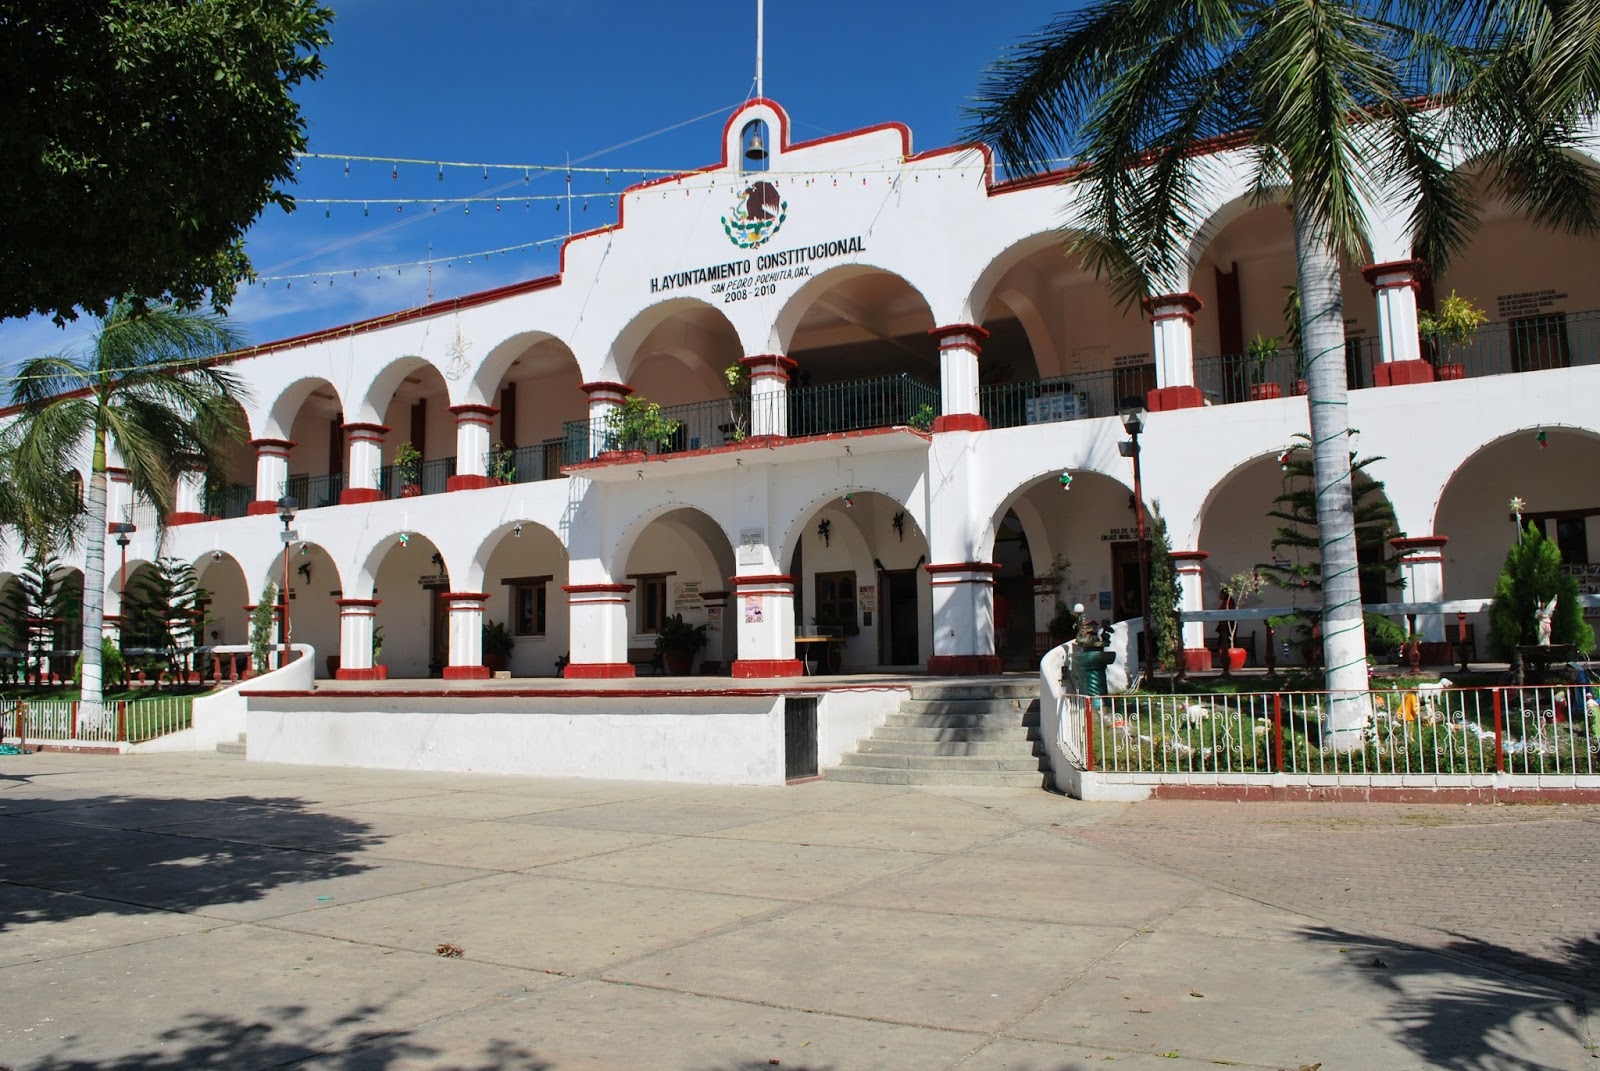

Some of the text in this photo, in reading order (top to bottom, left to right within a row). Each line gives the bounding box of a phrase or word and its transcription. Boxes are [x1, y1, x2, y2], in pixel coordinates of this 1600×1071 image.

[651, 236, 866, 293] H.AYUNTAMIENTO CONSTITUCIONAL
[711, 282, 725, 294] SAN
[726, 276, 753, 291] PEDRO
